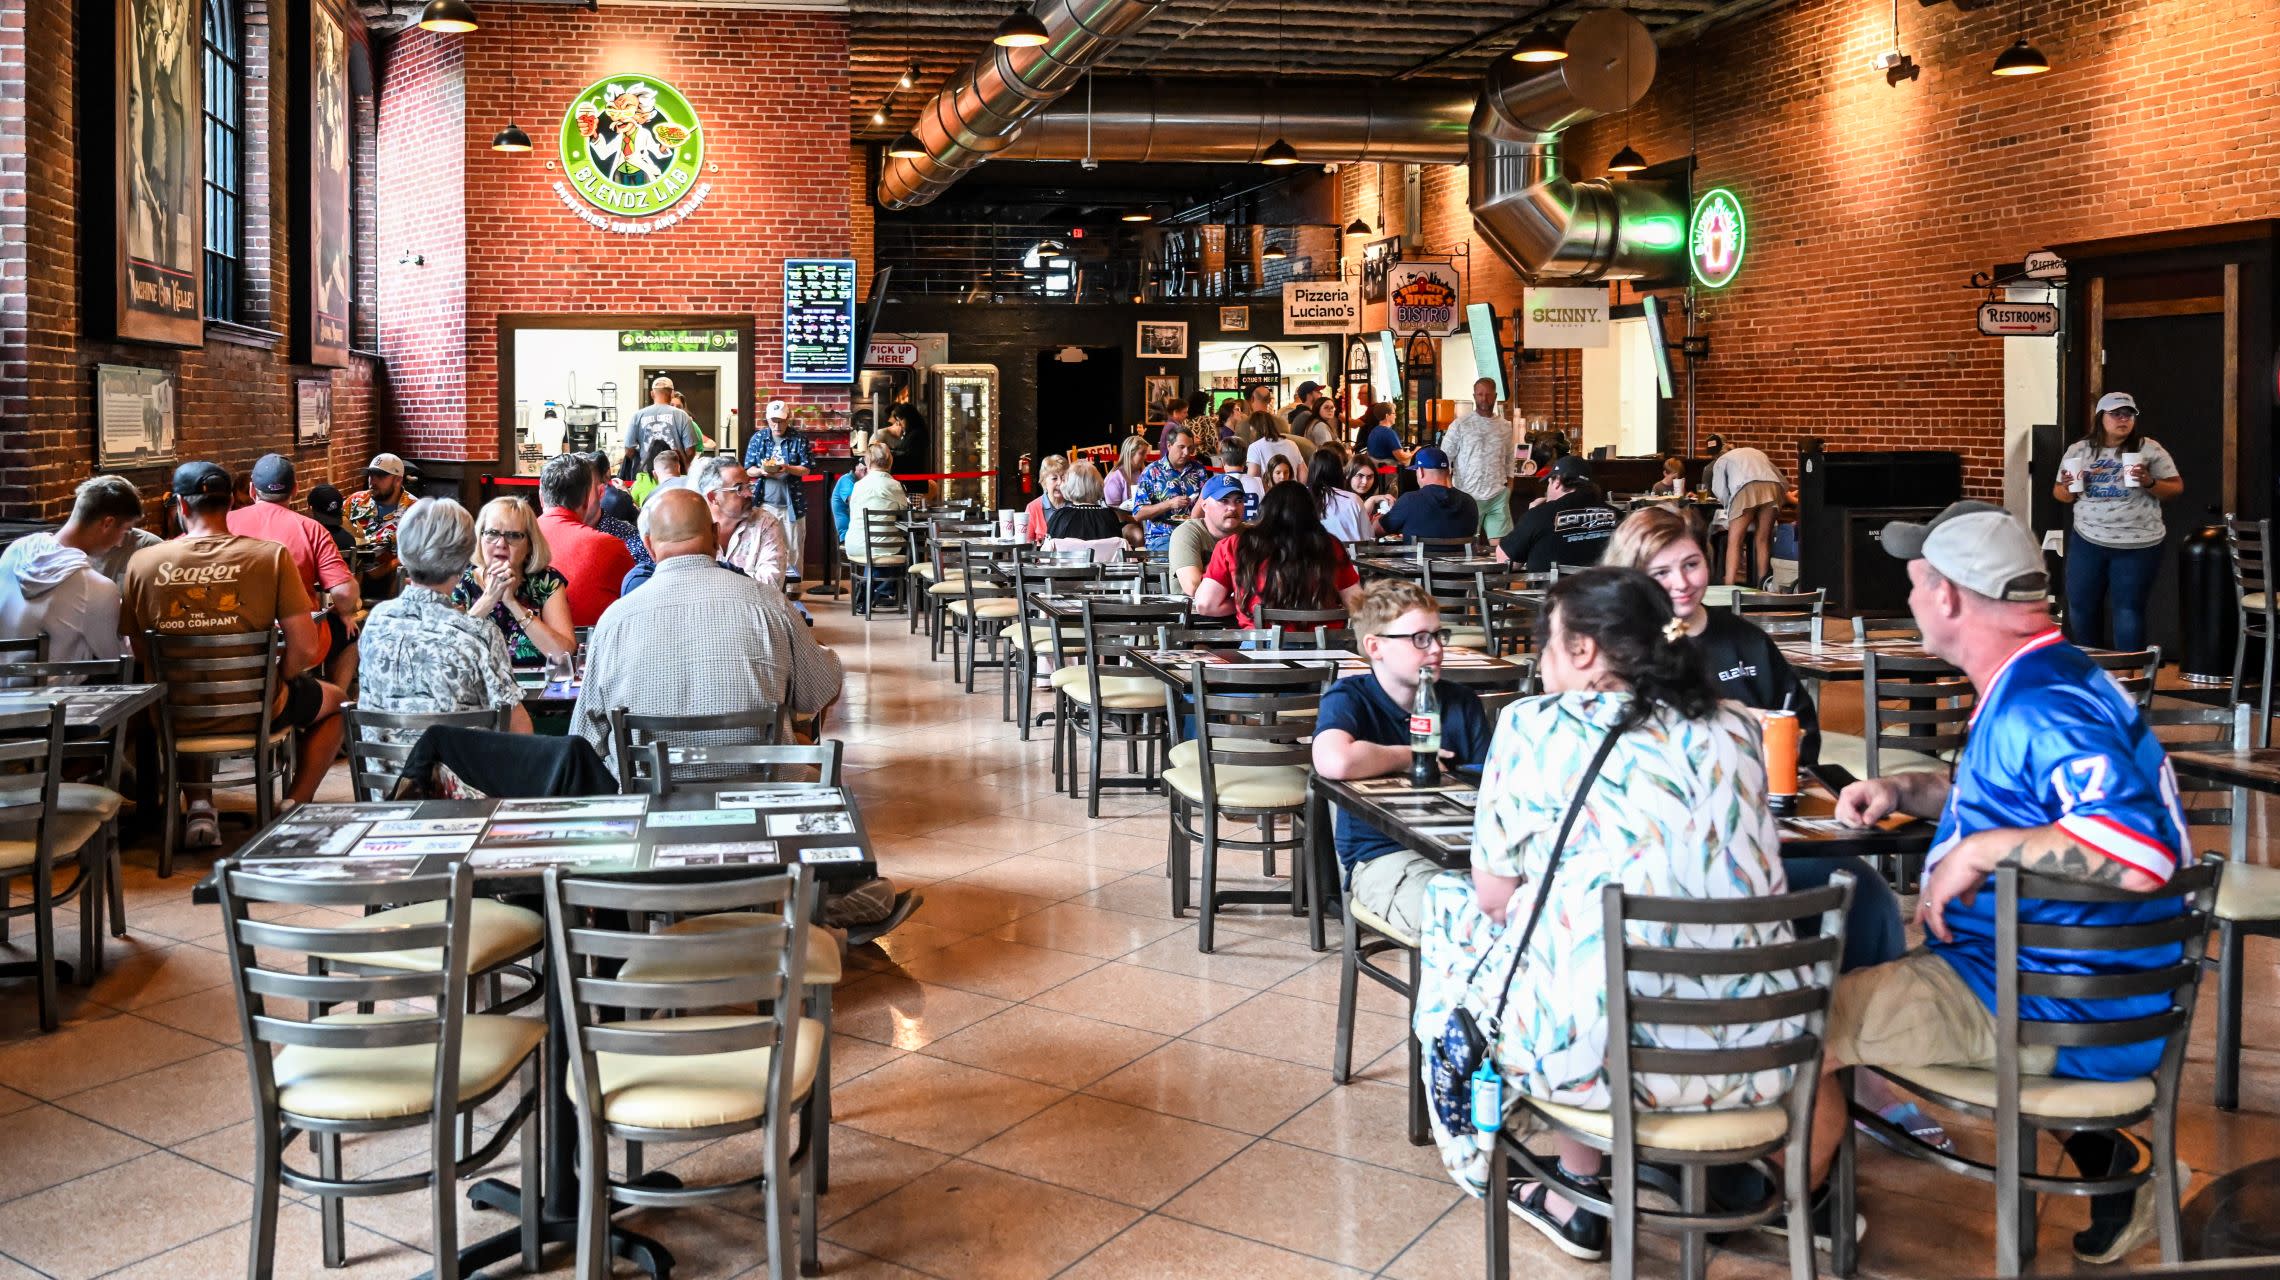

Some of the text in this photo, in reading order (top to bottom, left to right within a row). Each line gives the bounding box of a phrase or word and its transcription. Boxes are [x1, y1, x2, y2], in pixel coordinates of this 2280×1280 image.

[575, 166, 689, 209] BLENDZ LAB
[1295, 289, 1349, 302] Pizzeria
[1399, 284, 1418, 297] BIG
[1290, 304, 1355, 318] Luciano's
[1398, 307, 1450, 322] BISTRO
[1533, 308, 1602, 323] SKINNY.
[1986, 308, 2051, 323] RESTROOMS
[635, 336, 710, 344] ORGANIC GREENS
[870, 345, 912, 354] PICK UP
[877, 355, 905, 364] HERE
[154, 562, 241, 587] Seager
[159, 616, 240, 629] GOOD COMPANY
[2051, 754, 2108, 814] 17
